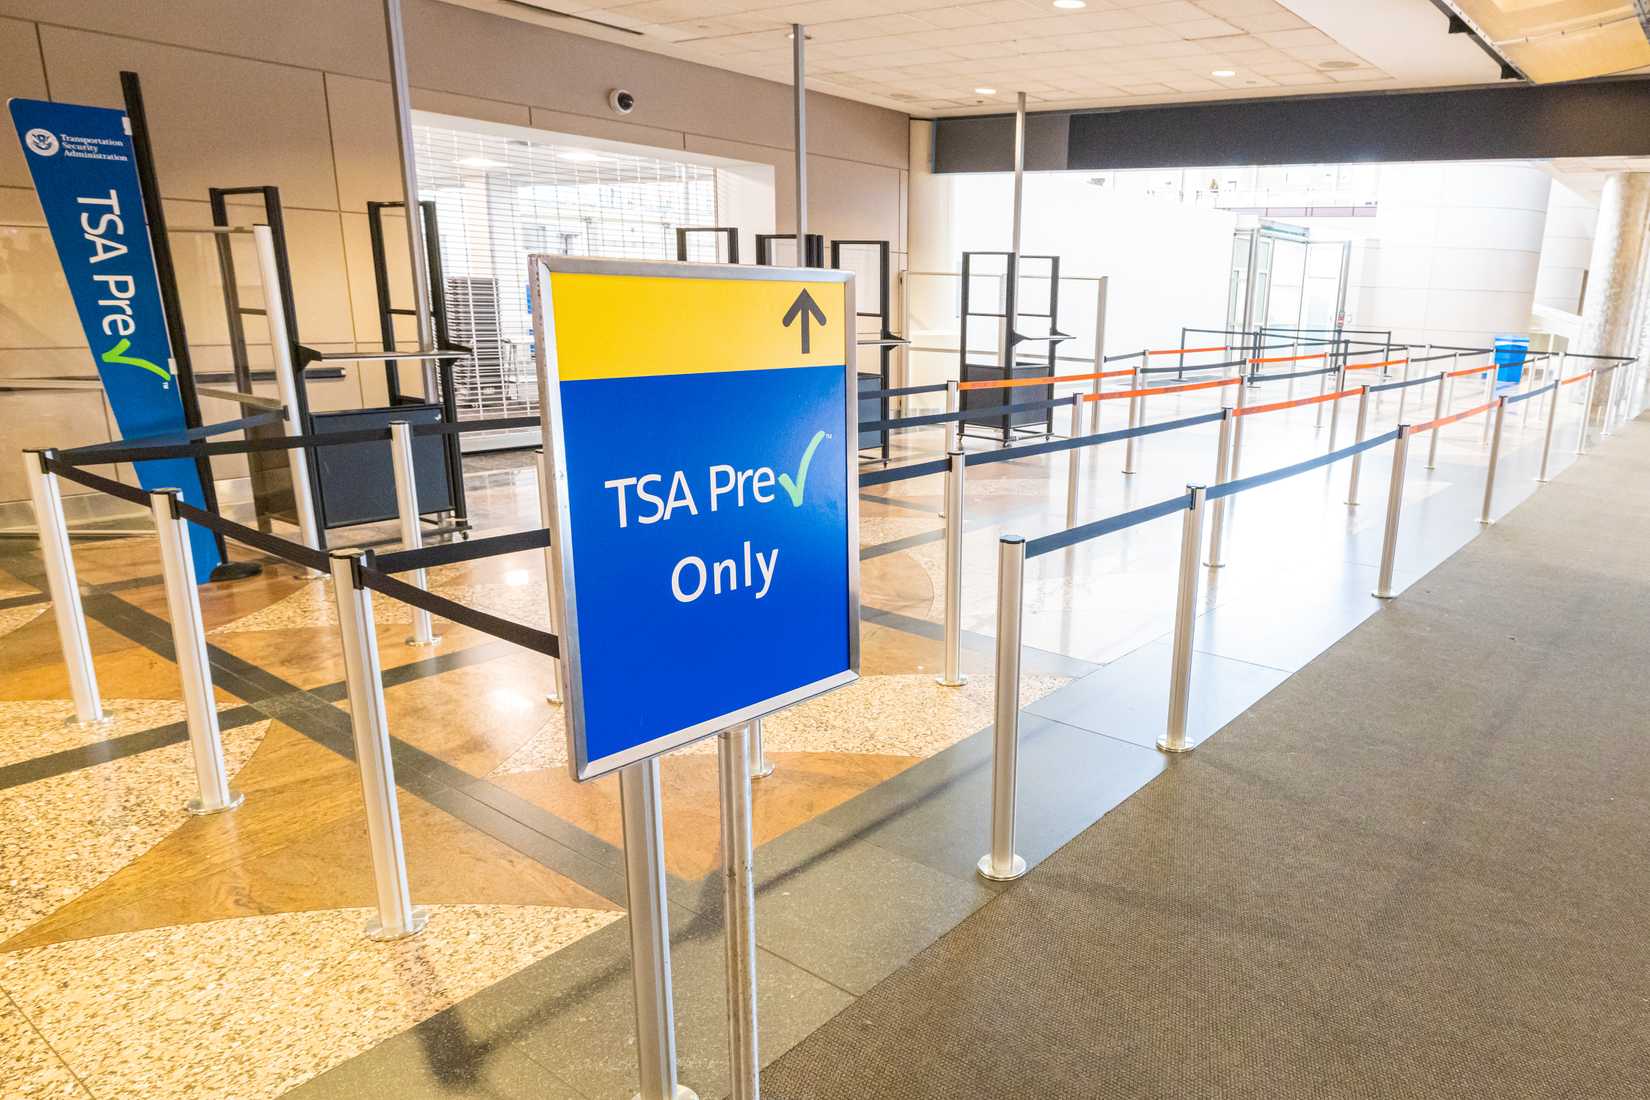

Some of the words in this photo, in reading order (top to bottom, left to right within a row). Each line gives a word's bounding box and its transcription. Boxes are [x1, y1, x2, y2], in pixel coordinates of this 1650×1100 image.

[60, 133, 124, 147] Transportation
[61, 142, 98, 153] Security
[64, 149, 128, 161] Administration
[76, 188, 129, 264] TSA
[92, 274, 137, 336] Pre
[604, 470, 699, 529] TSA
[709, 464, 776, 512] Pre
[671, 540, 779, 603] Only
